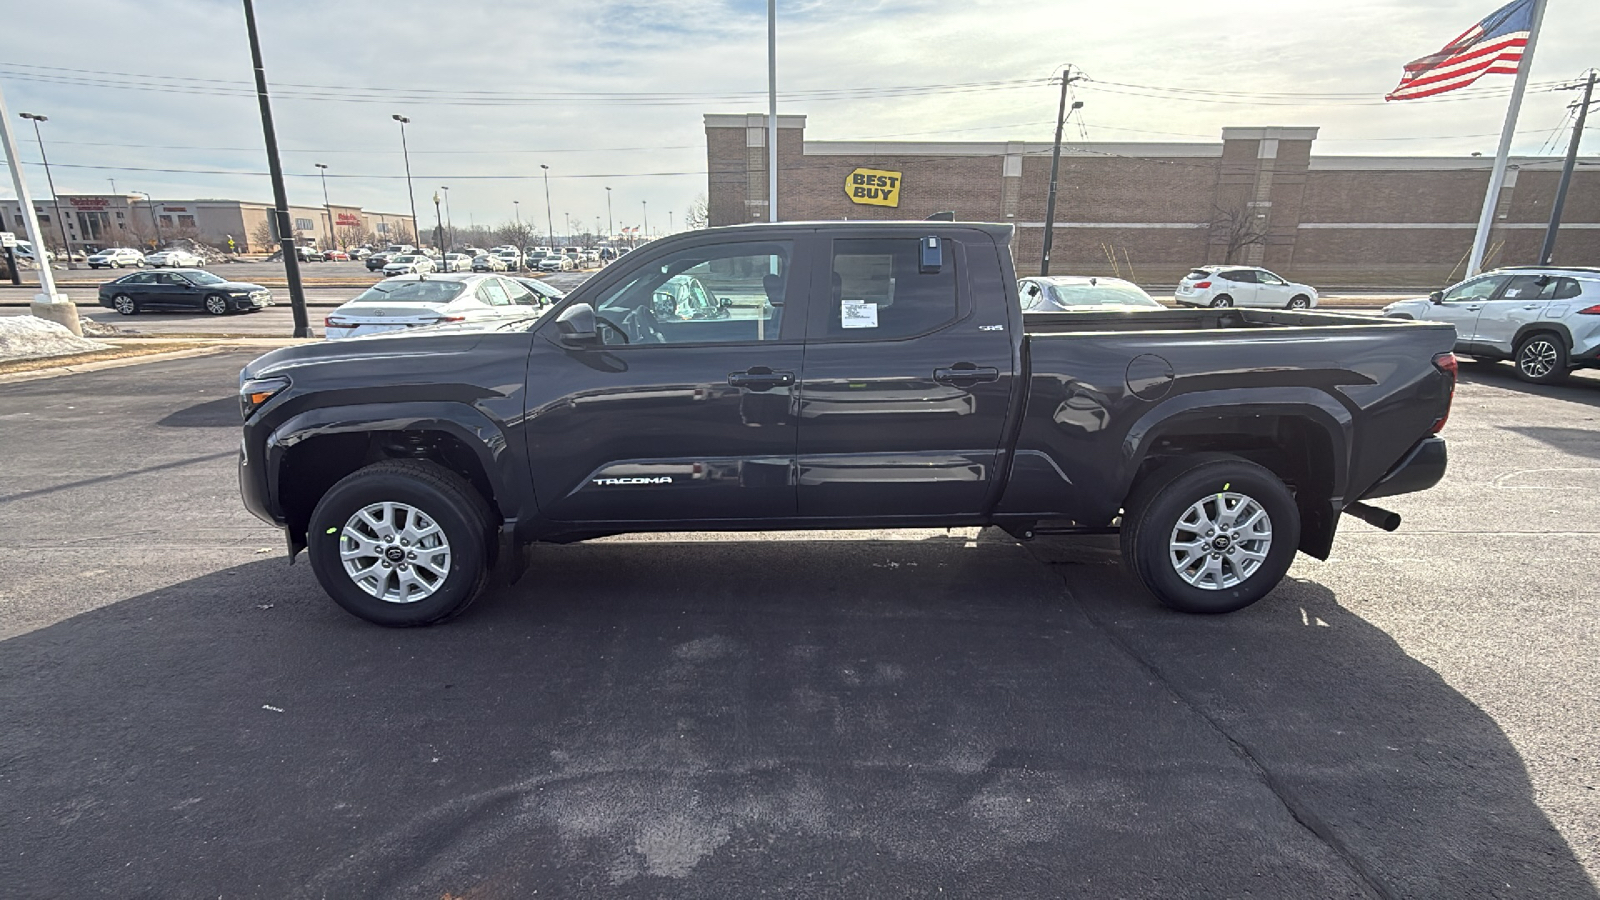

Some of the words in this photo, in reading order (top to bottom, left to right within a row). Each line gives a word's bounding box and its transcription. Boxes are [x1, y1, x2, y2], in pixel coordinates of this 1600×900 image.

[853, 173, 898, 188] BEST
[853, 186, 893, 200] BUY
[592, 476, 673, 486] TACOMA
